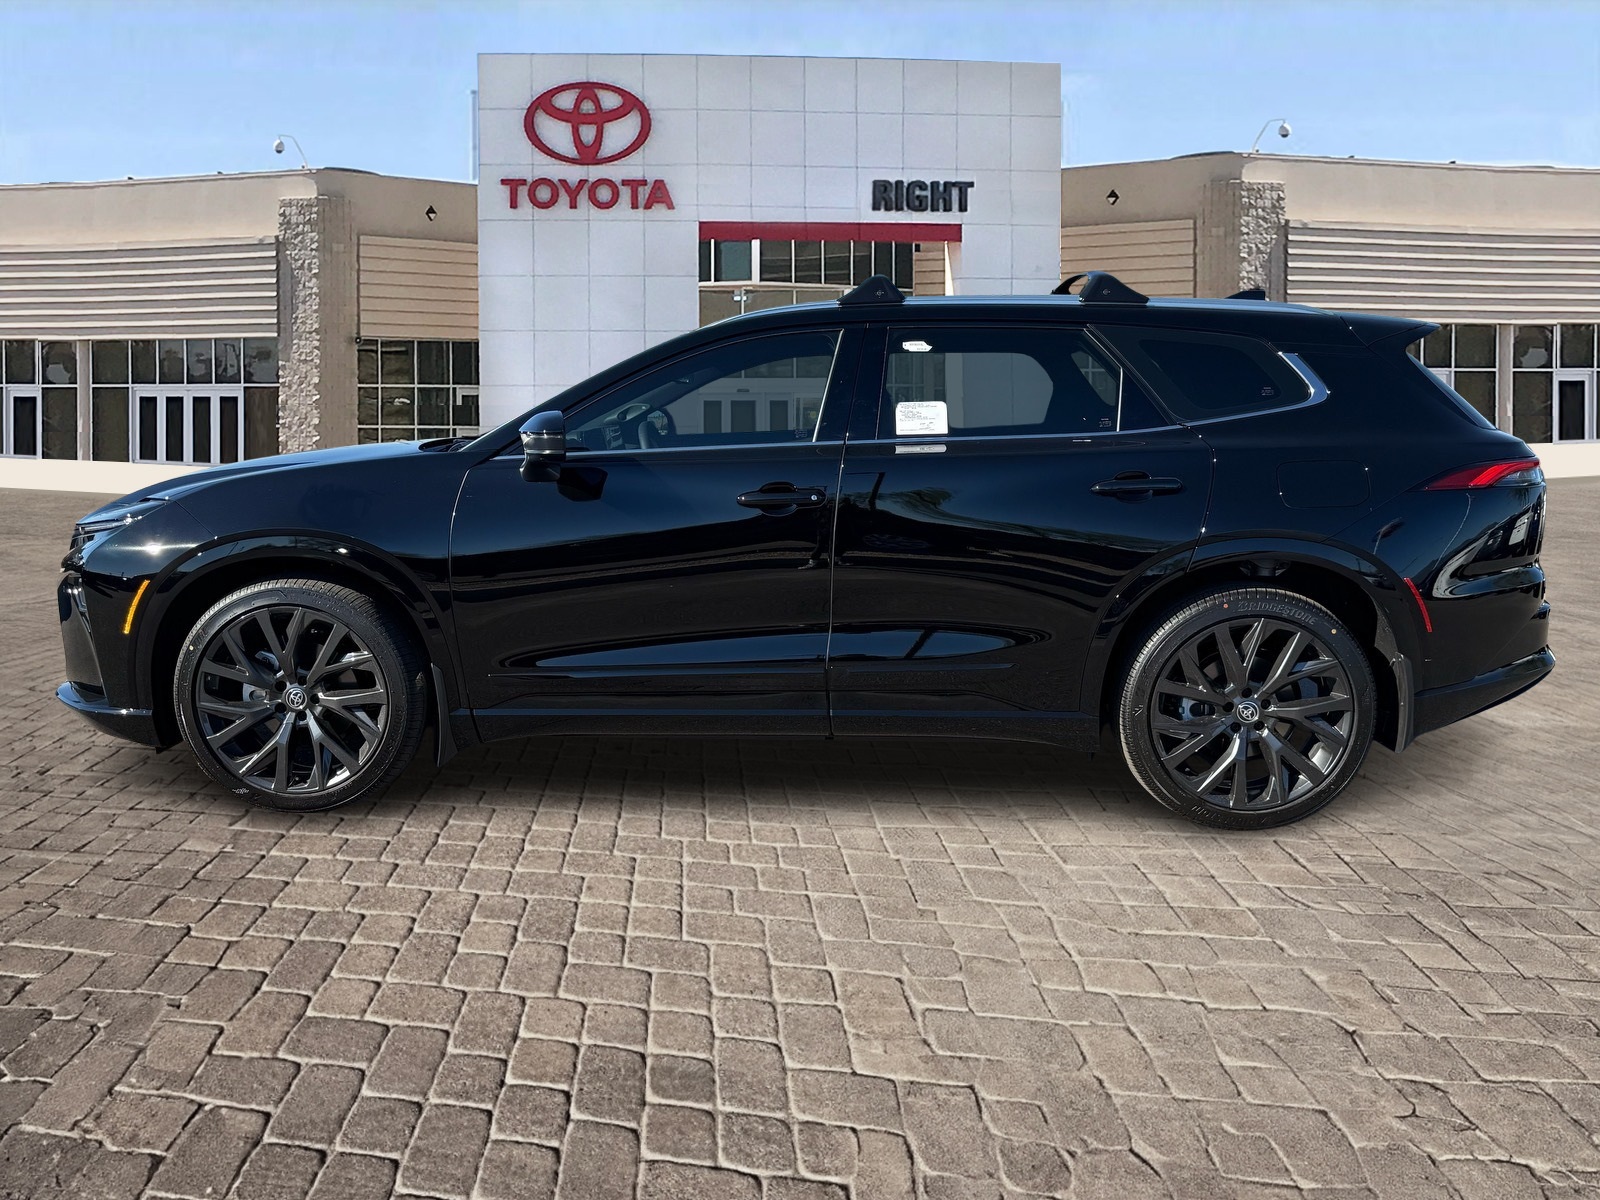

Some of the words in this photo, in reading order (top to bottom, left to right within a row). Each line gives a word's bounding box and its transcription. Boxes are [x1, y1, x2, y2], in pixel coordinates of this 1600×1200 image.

[501, 178, 675, 209] TOYOTA
[871, 179, 975, 212] RIGHT
[1238, 600, 1319, 626] BRIDGESTONE
